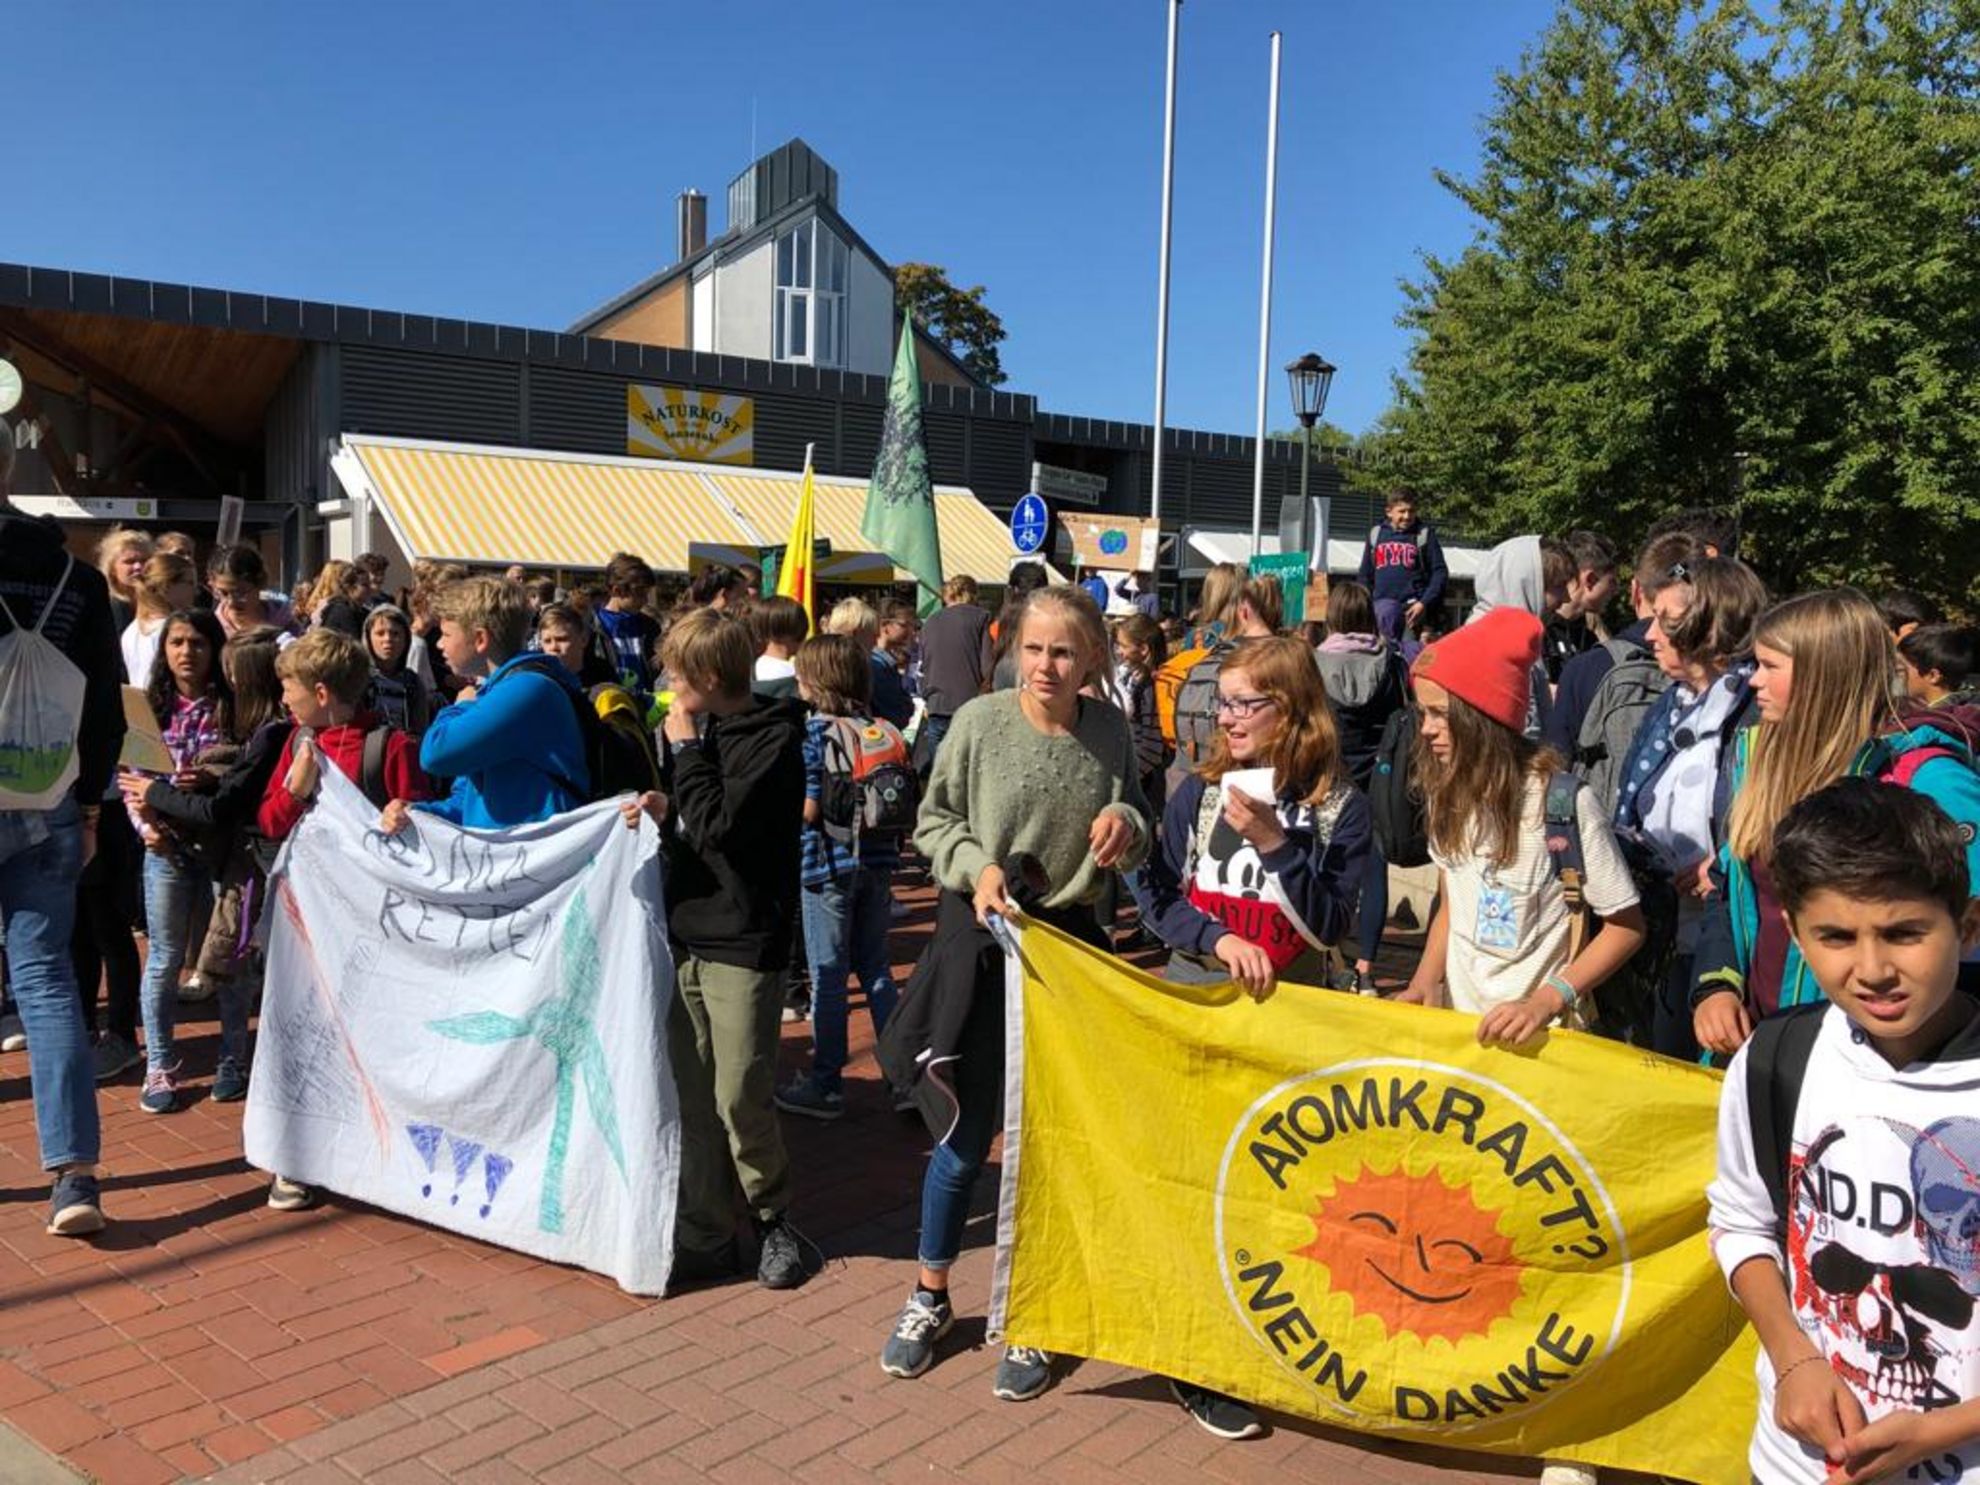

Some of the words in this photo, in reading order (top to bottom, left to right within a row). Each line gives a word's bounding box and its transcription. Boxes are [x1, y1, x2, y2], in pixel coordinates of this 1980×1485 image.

[641, 404, 742, 434] NATURKOST
[1374, 541, 1417, 569] NYC
[1249, 1077, 1609, 1260] ATOMKRAFT?
[1238, 1261, 1368, 1403] NEIN
[1395, 1312, 1594, 1422] DANKE
